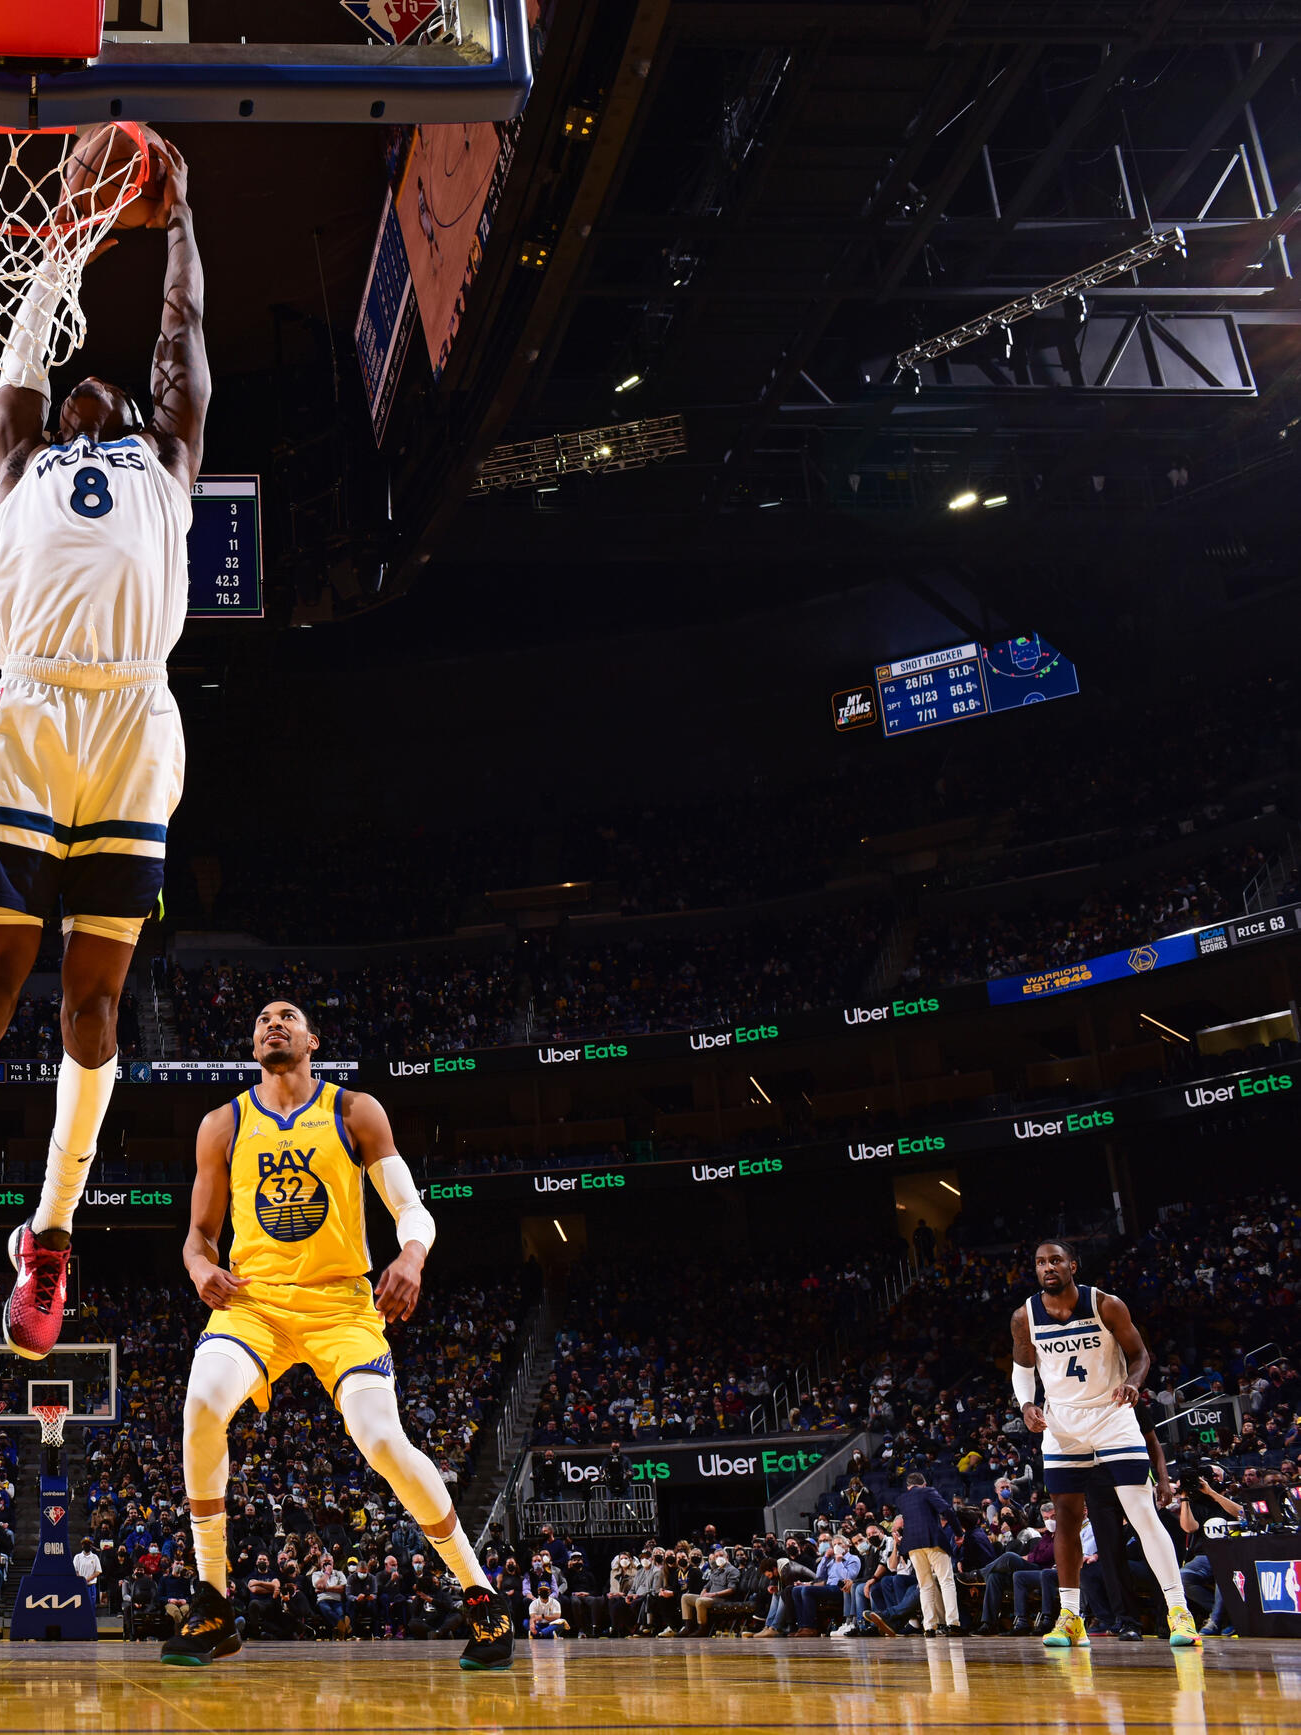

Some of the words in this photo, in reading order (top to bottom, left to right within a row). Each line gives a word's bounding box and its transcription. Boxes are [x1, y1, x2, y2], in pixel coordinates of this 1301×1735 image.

[70, 466, 113, 519] 8
[230, 503, 237, 515] 3
[231, 521, 238, 533] 7
[228, 539, 239, 551] 11
[225, 557, 239, 569] 32
[215, 575, 240, 587] 42.3
[216, 593, 240, 605] 76.2
[900, 658, 923, 672] SHOT
[924, 648, 963, 666] TRACKER
[884, 685, 896, 694] FG
[905, 673, 934, 690] 26/51
[838, 701, 871, 719] TEAMS
[846, 693, 862, 706] MY
[886, 701, 902, 711] 3PT
[909, 690, 938, 706] 13/23
[889, 719, 899, 728] FT
[916, 707, 937, 722] 7/11
[1199, 927, 1225, 940] NCAA
[1238, 922, 1266, 937] RICE
[1269, 916, 1286, 931] 63
[1200, 940, 1228, 954] SCORES
[1026, 964, 1088, 985] WARRIORS
[844, 1004, 889, 1025] Uber
[893, 997, 940, 1017] Eats
[690, 1031, 732, 1050] Uber
[735, 1024, 779, 1043] Eats
[538, 1047, 580, 1064] Uber
[584, 1043, 628, 1060] Eats
[160, 1072, 168, 1081] 12
[187, 1072, 192, 1081] 5
[211, 1072, 220, 1081] 21
[238, 1072, 244, 1081] 6
[314, 1072, 322, 1081] 11
[339, 1072, 349, 1081] 32
[389, 1060, 430, 1077] Uber
[433, 1056, 476, 1074] Eats
[1185, 1082, 1236, 1108] Uber
[1239, 1073, 1294, 1098] Eats
[300, 1120, 330, 1129] Rakuten
[1013, 1119, 1063, 1140] Uber
[1066, 1109, 1115, 1132] Eats
[276, 1140, 293, 1151] The
[848, 1141, 894, 1162] Uber
[898, 1134, 946, 1156] Eats
[258, 1148, 316, 1178] BAY
[692, 1163, 735, 1182] Uber
[738, 1156, 783, 1177] Eats
[271, 1176, 305, 1204] 32
[430, 1183, 473, 1201] Eats
[534, 1175, 577, 1193] Uber
[581, 1172, 626, 1190] Eats
[85, 1189, 127, 1205] Uber
[130, 1189, 172, 1206] Eats
[1040, 1336, 1102, 1354] WOLVES
[1066, 1356, 1088, 1382] 4
[1187, 1410, 1223, 1426] Uber
[698, 1453, 757, 1477] Uber
[762, 1450, 822, 1473] Eats
[44, 1542, 64, 1555] @NBA
[1260, 1571, 1282, 1601] NBA
[25, 1594, 82, 1609] KIA
